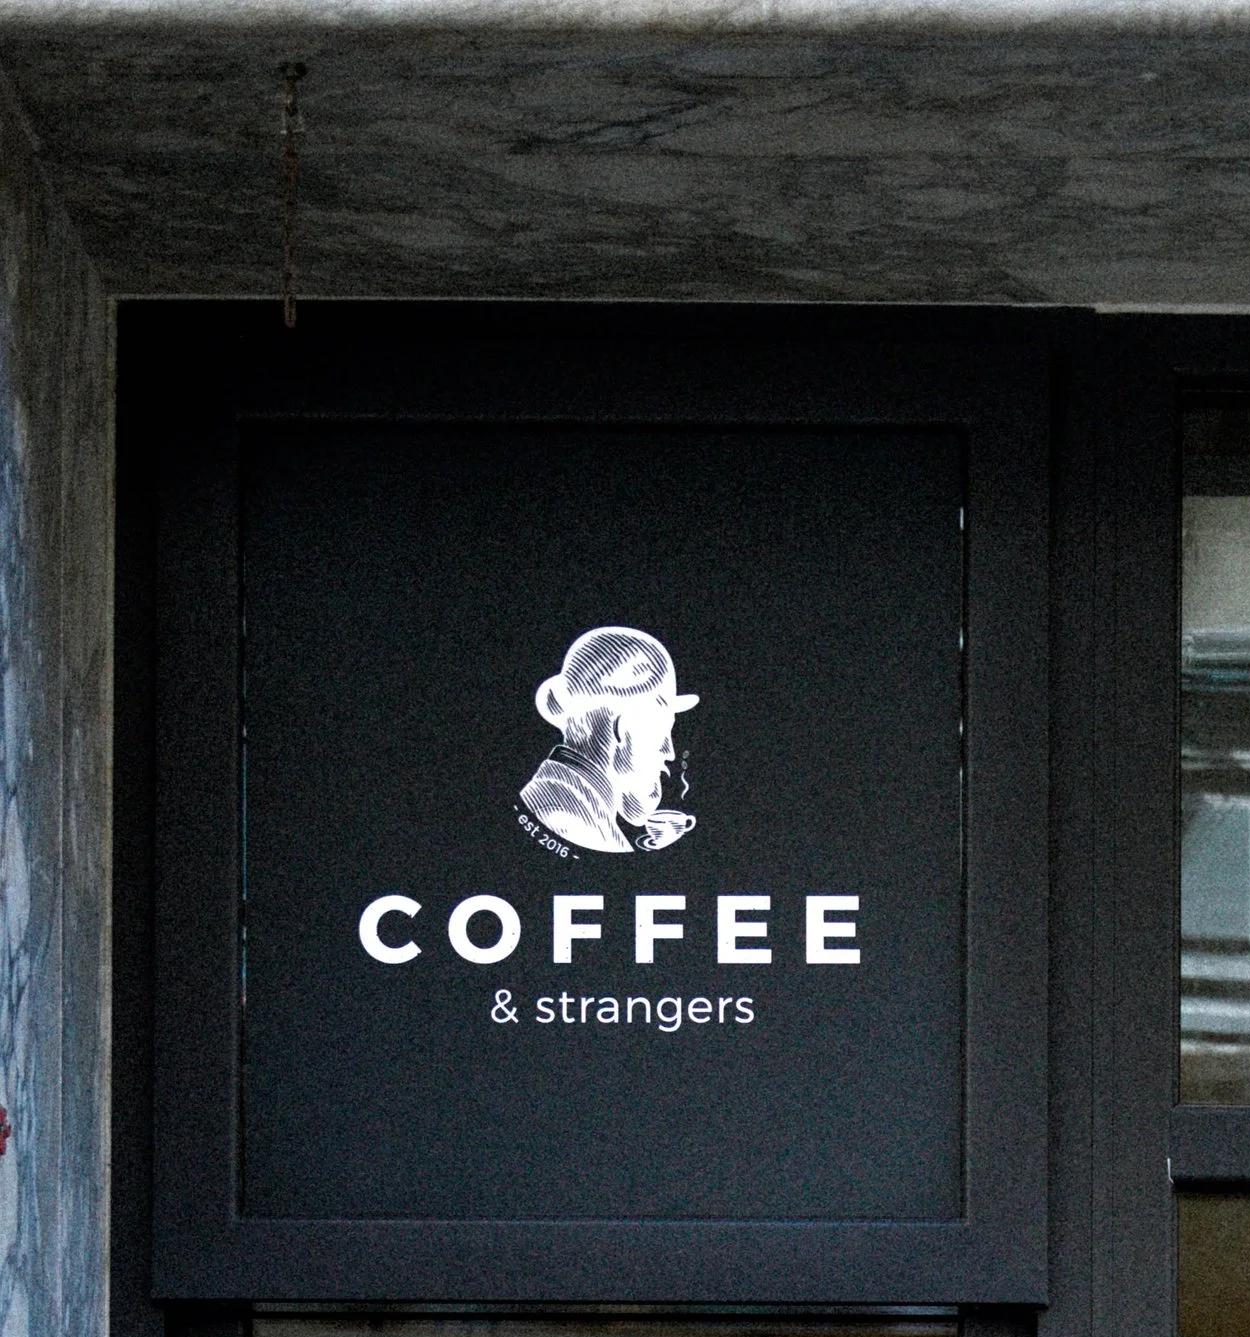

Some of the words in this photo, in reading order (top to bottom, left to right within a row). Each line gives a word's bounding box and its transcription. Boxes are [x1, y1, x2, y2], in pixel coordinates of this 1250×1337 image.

[518, 814, 540, 838] est
[538, 833, 570, 858] 2016
[358, 894, 861, 965] COFFEE
[490, 989, 519, 1024] &
[535, 990, 755, 1032] strangers
